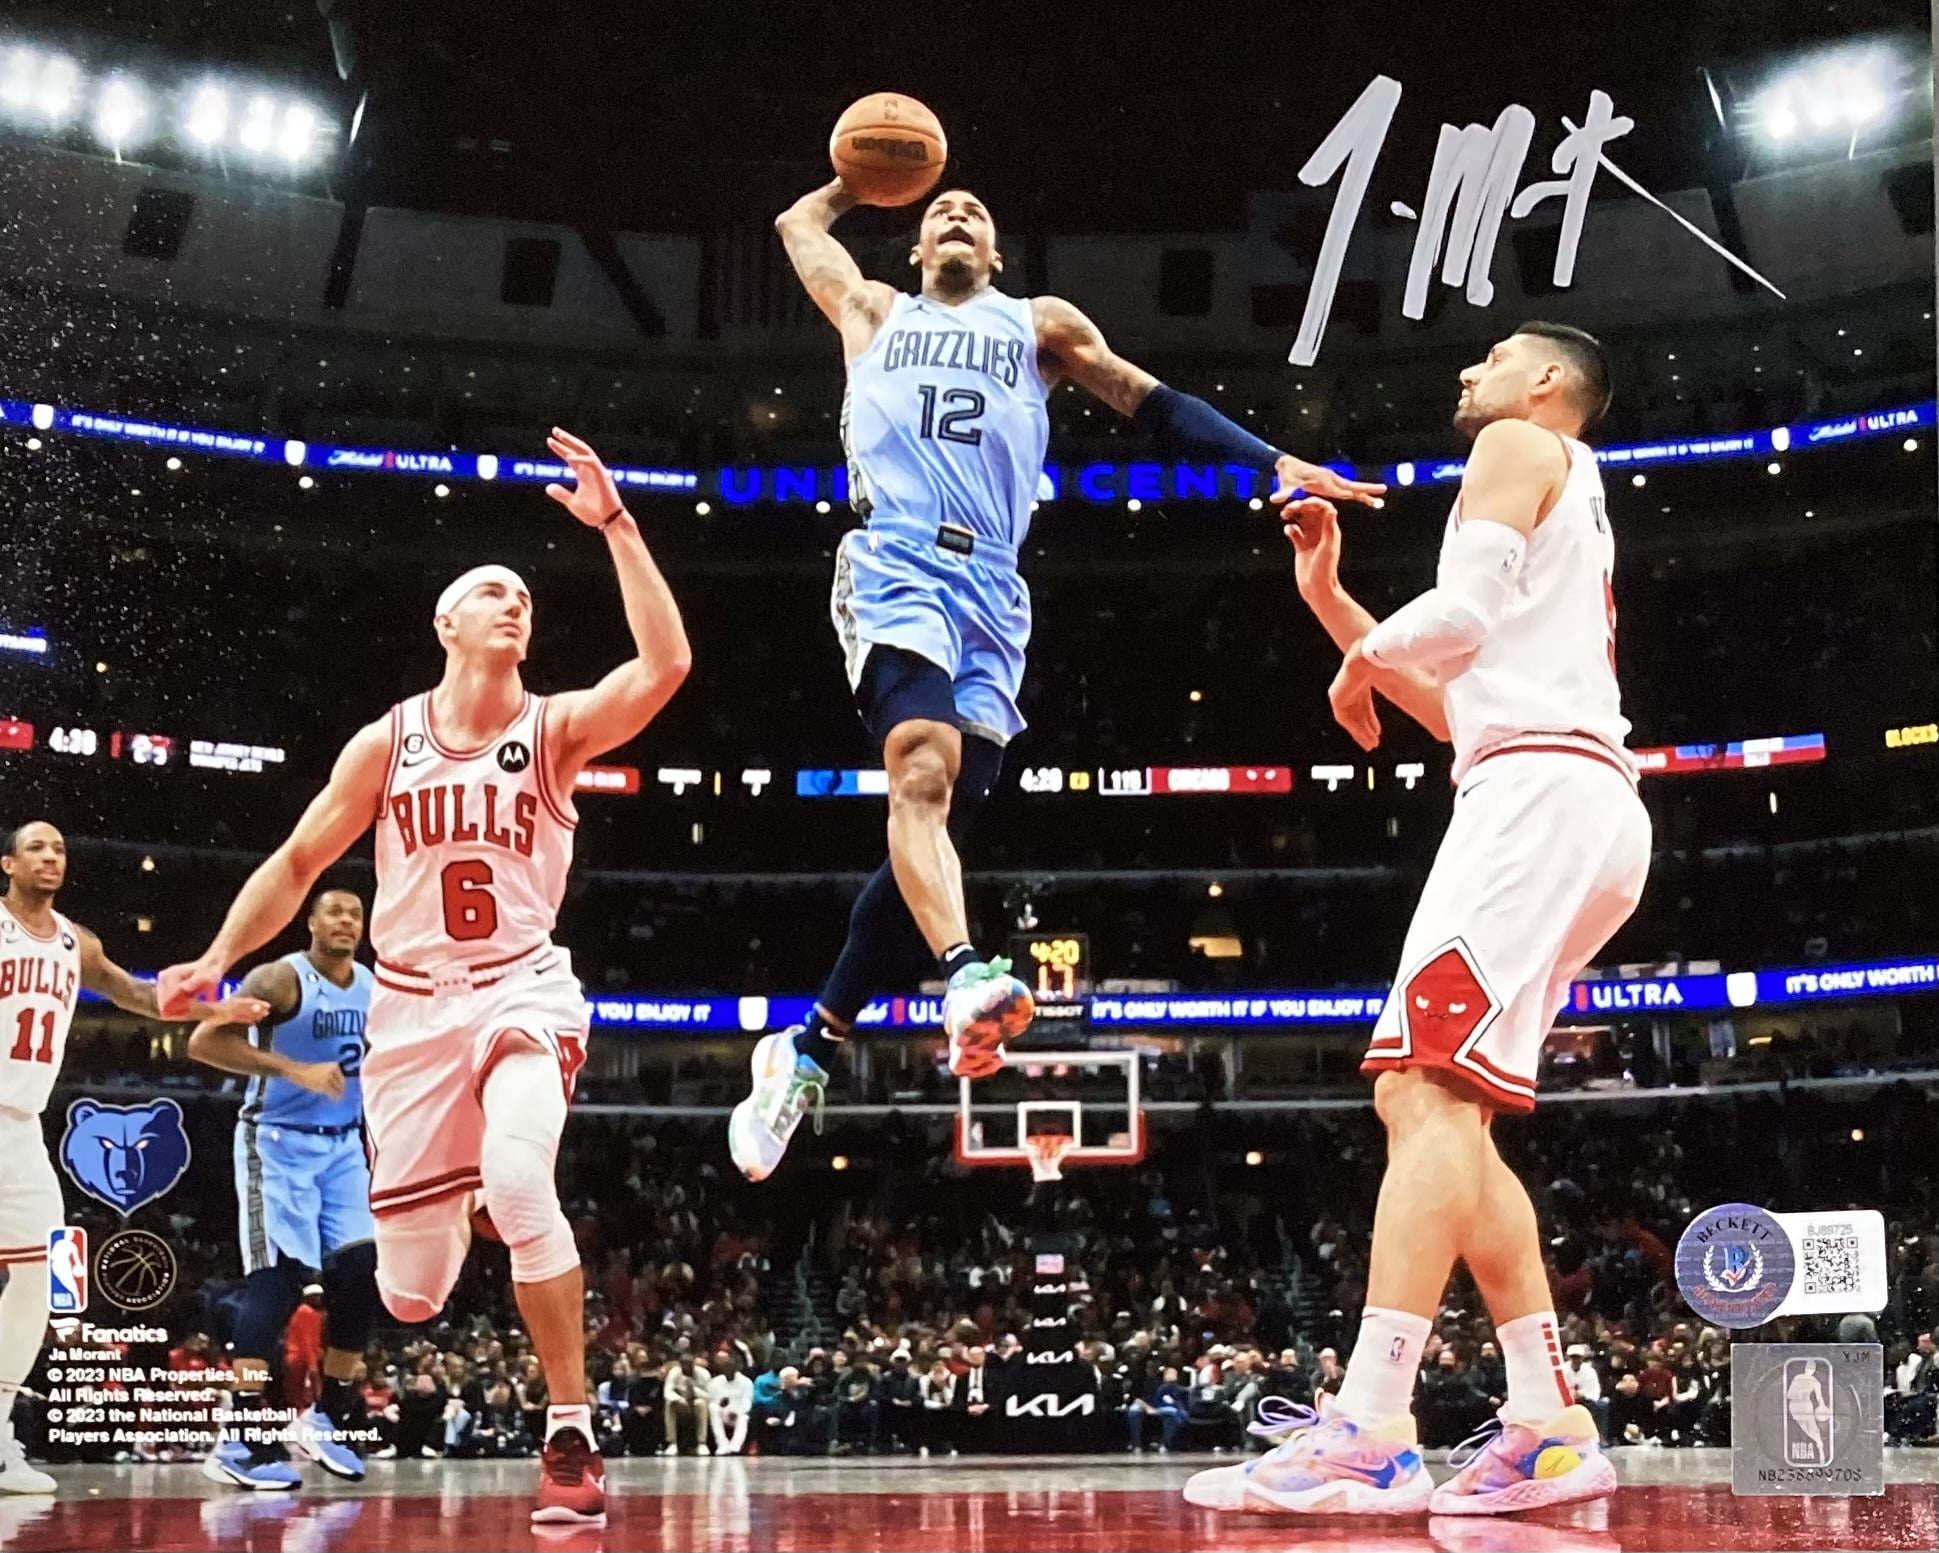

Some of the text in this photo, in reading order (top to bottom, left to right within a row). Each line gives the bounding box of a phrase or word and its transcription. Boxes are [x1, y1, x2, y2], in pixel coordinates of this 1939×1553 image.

[884, 329, 1025, 389] GRIZZLIES
[918, 384, 986, 446] 12
[1867, 410, 1918, 430] ULTRA
[396, 454, 453, 471] ULTRA
[390, 783, 538, 859] BULLS
[441, 858, 498, 942] 6
[1030, 940, 1080, 964] 4:20
[0, 957, 76, 1011] BULLS
[1038, 963, 1074, 998] 17
[1785, 965, 1933, 994] IT'S ONLY WORTH
[1269, 999, 1304, 1017] YOU
[1591, 983, 1683, 1008] ULTRA
[597, 1002, 632, 1020] YOU
[10, 1007, 56, 1064] 11
[1696, 1216, 1774, 1244] BECKETT
[1791, 1441, 1815, 1460] NBA
